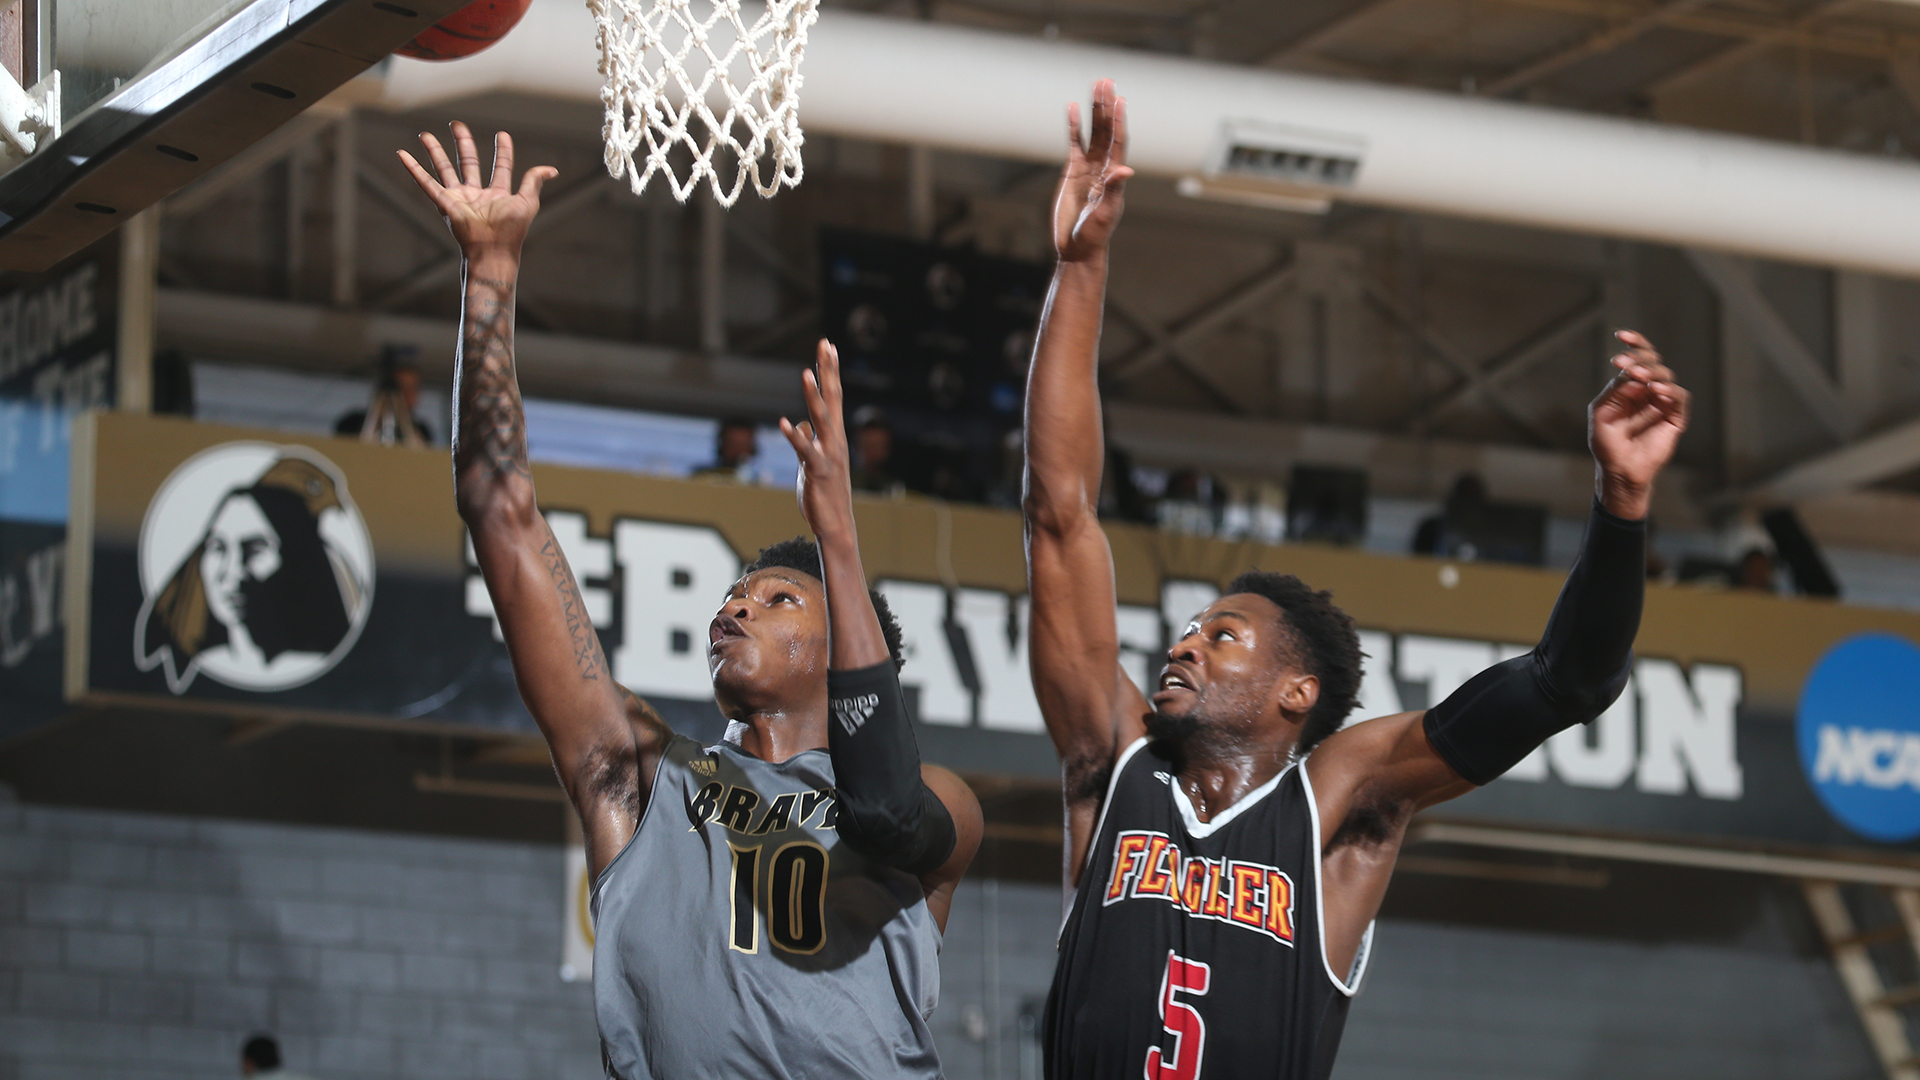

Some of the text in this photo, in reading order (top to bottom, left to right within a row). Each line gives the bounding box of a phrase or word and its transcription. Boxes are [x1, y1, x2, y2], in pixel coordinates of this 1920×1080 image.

[688, 760, 716, 778] adid
[726, 840, 830, 955] 10
[1143, 948, 1211, 1080] 5
